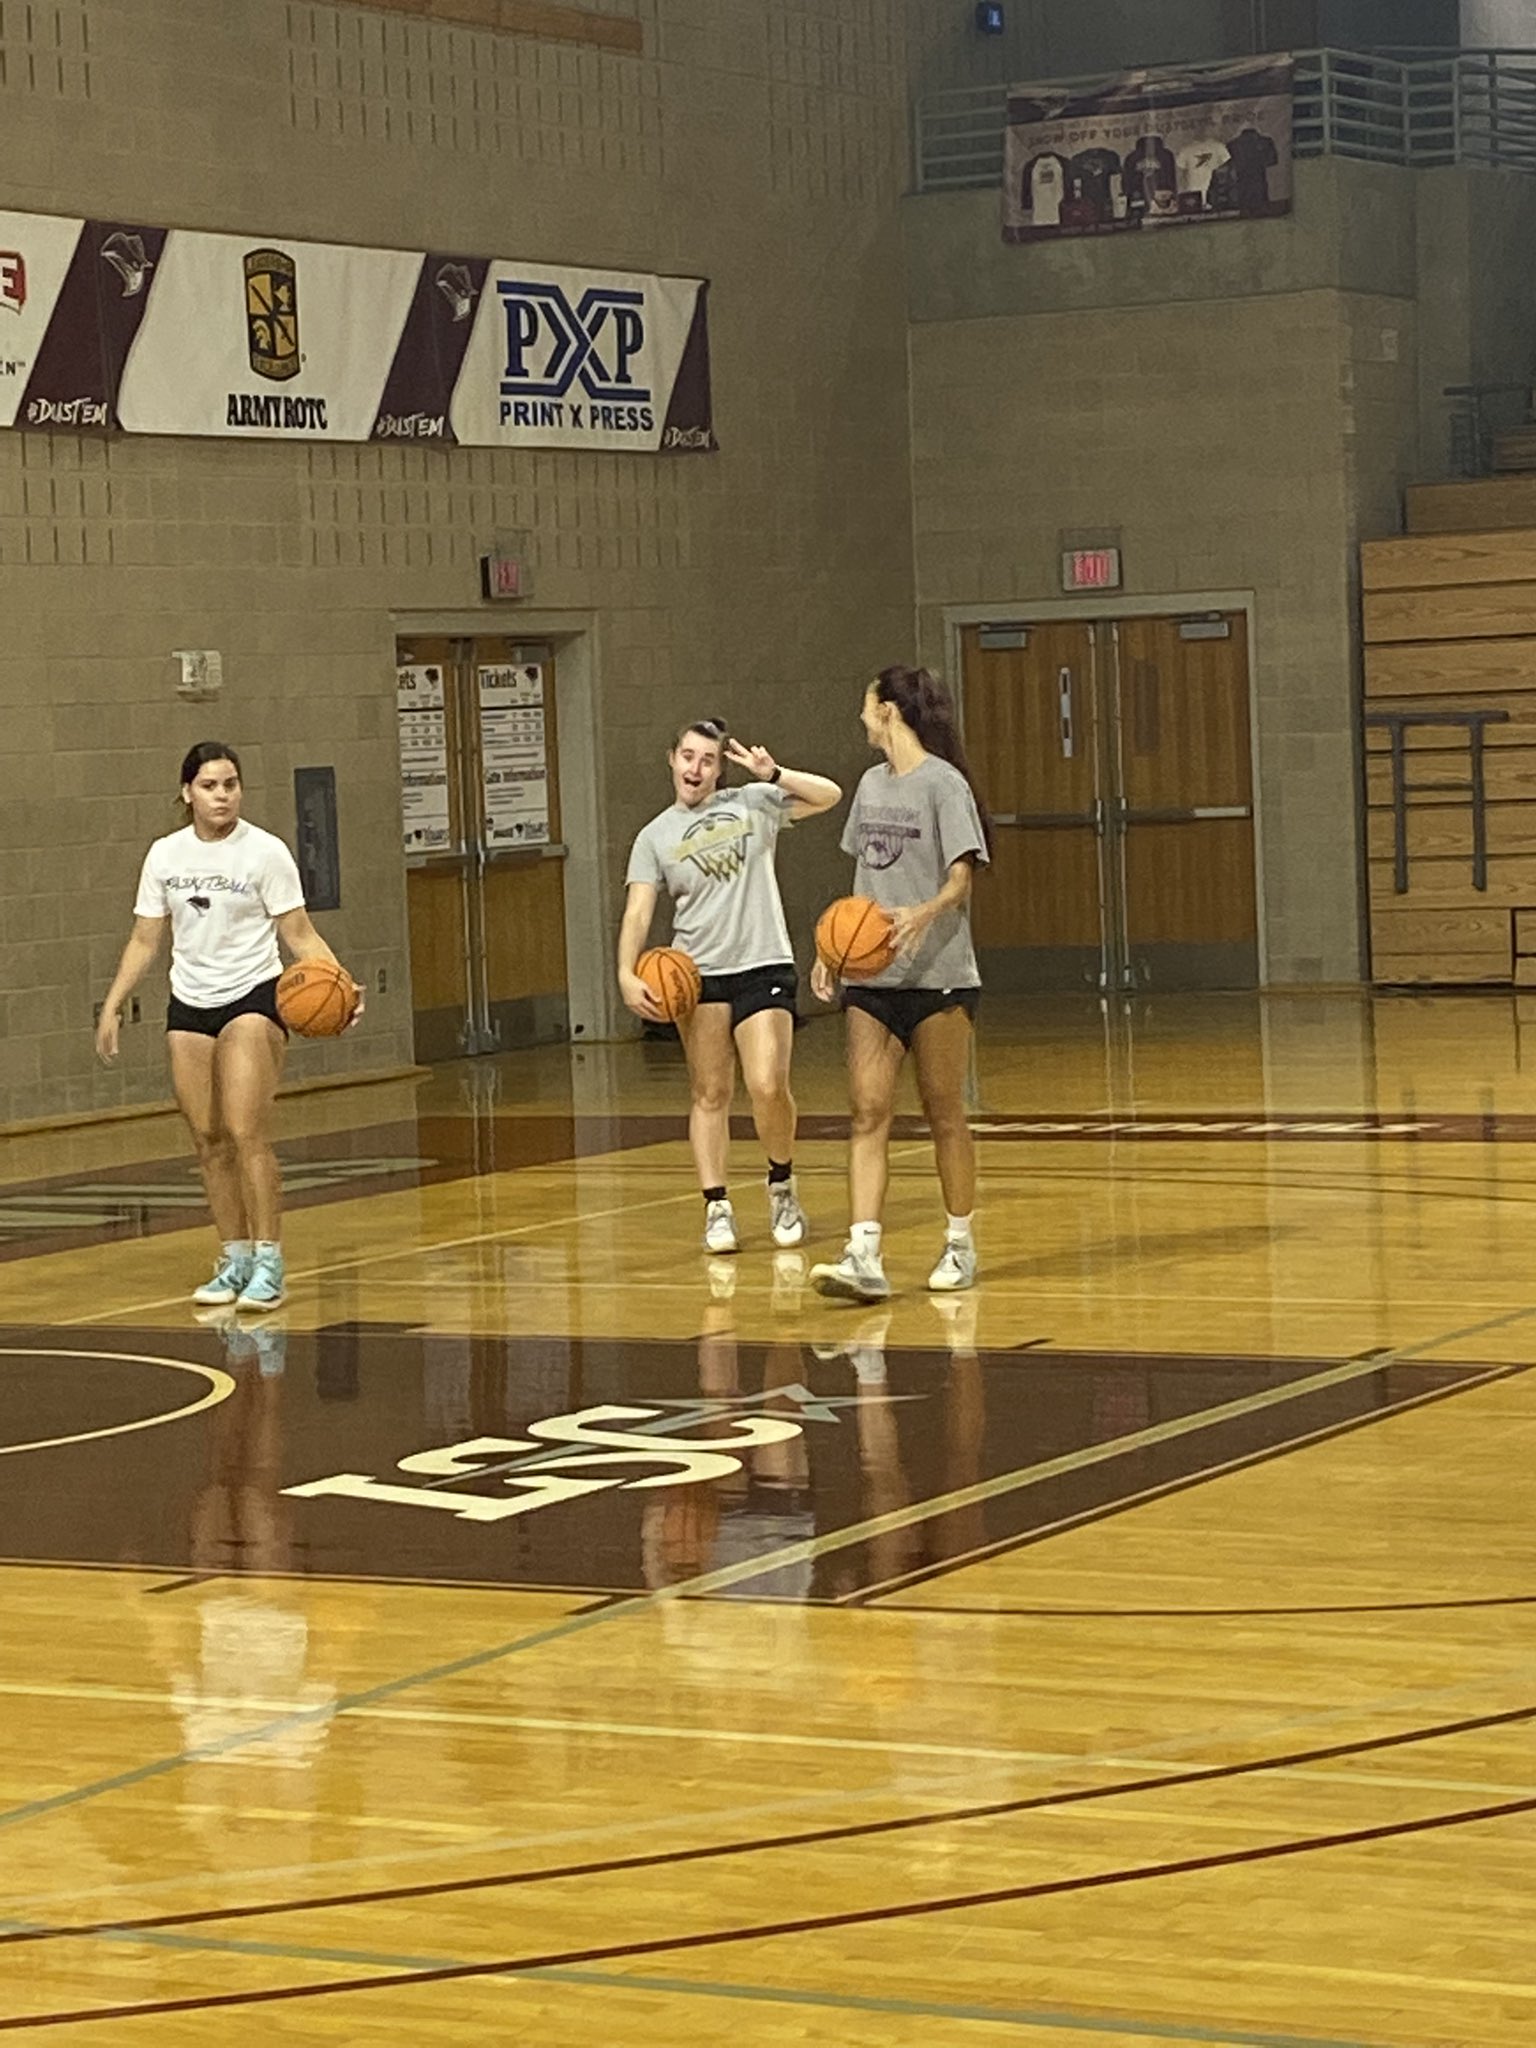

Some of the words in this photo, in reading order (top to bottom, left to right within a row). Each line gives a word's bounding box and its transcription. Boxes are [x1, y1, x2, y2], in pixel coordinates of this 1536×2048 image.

[500, 401, 564, 428] PRINT
[570, 403, 583, 429] X
[590, 404, 654, 431] PRESS
[479, 668, 517, 690] Tickets
